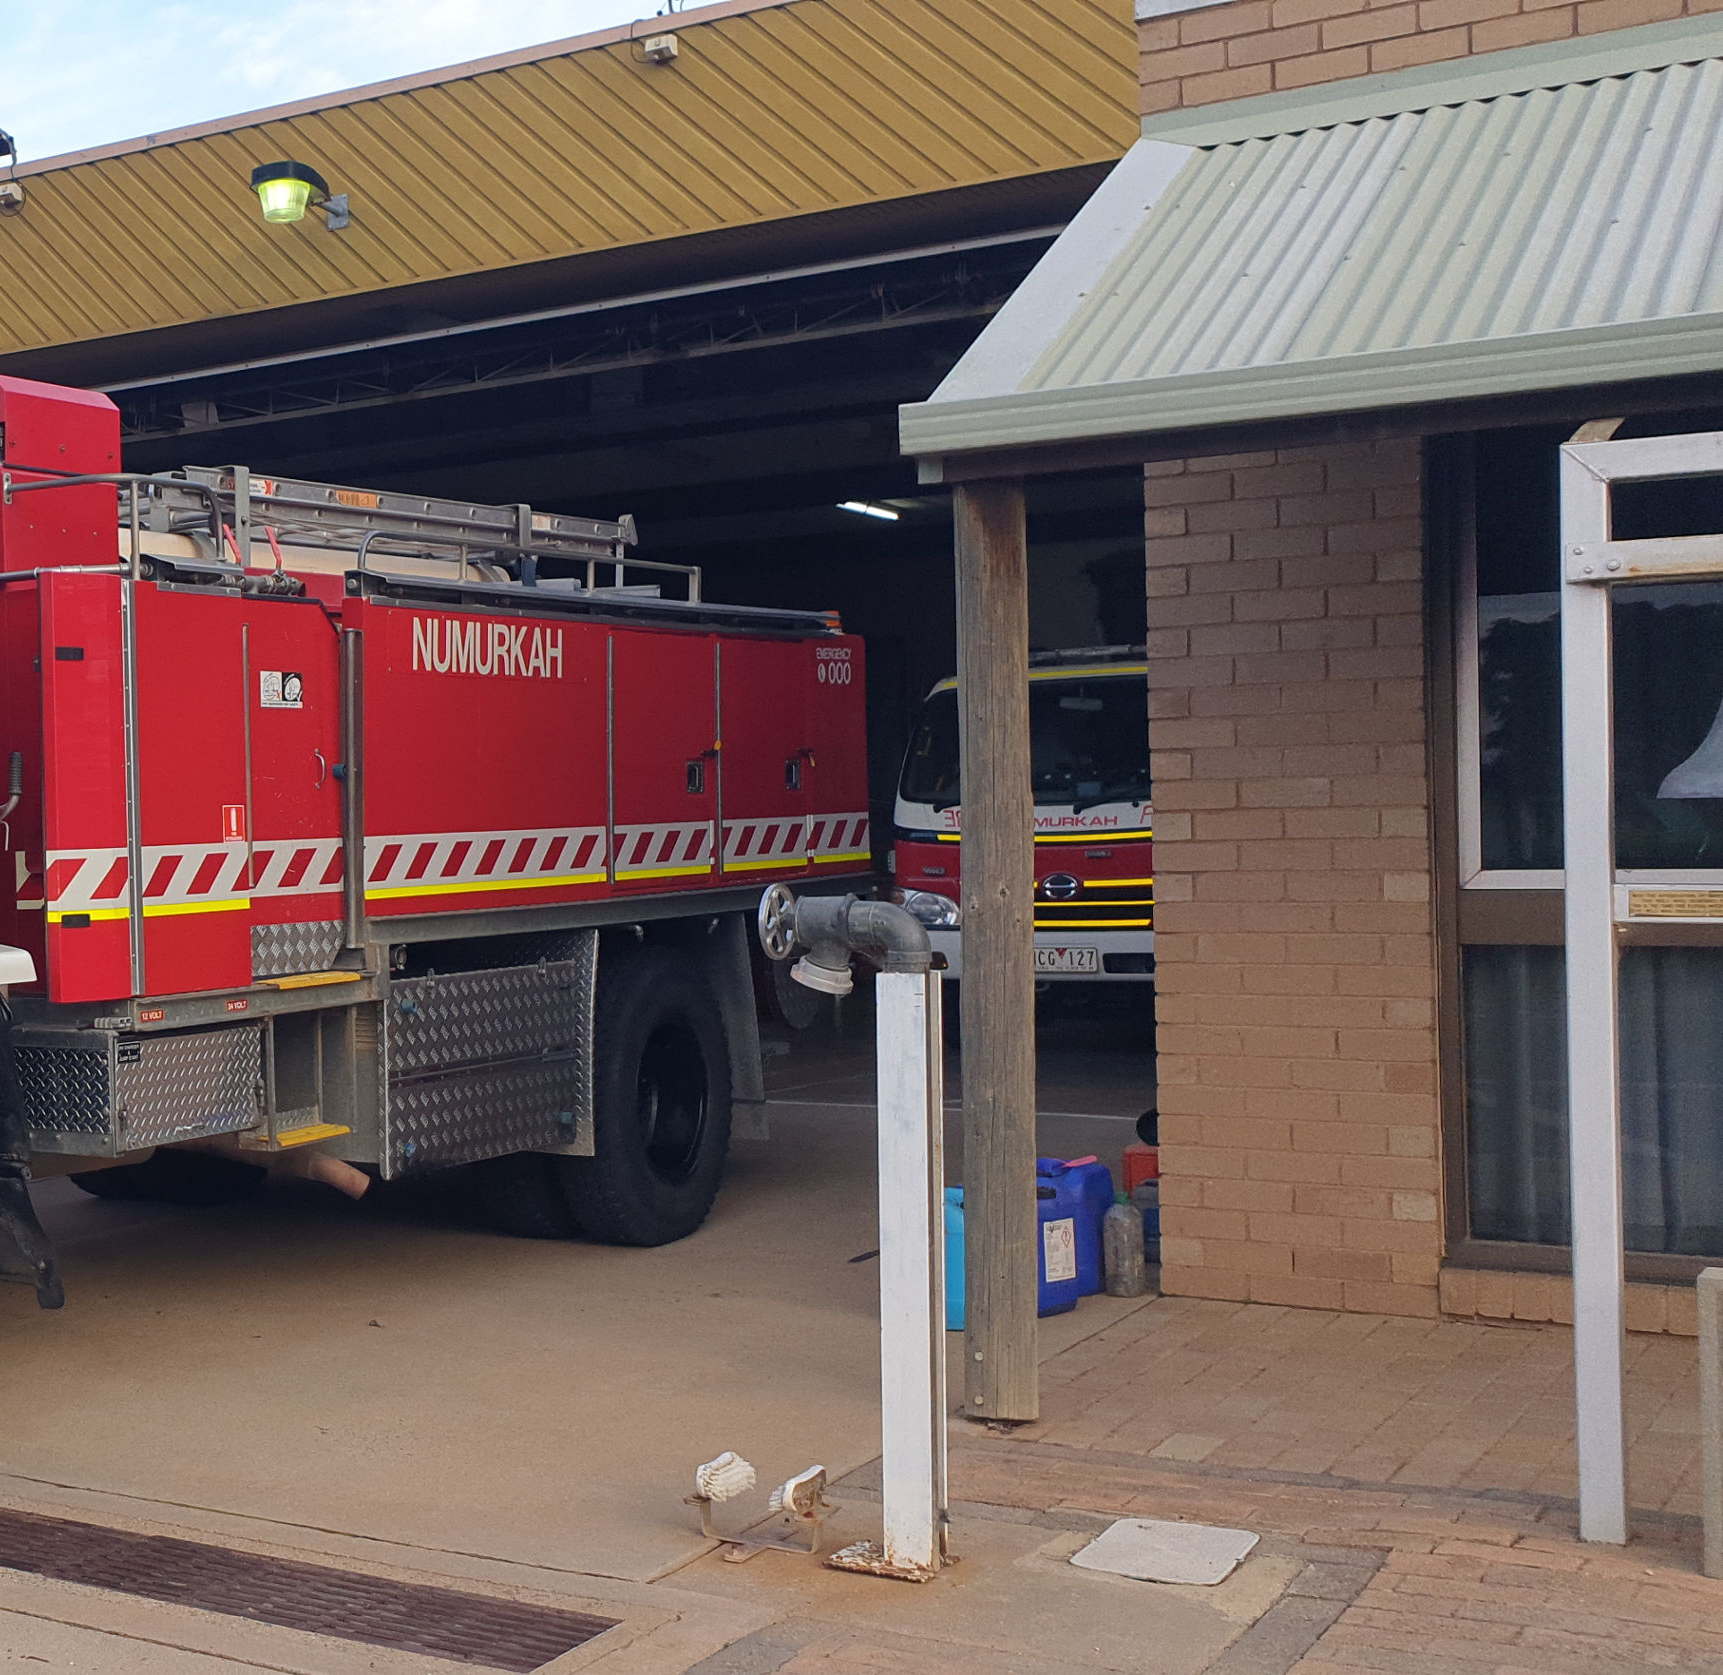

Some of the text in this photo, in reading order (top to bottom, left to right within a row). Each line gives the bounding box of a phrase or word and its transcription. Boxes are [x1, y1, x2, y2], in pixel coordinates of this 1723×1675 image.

[412, 616, 563, 679] NUMURKAH
[828, 661, 852, 685] 000
[1034, 815, 1118, 828] MURKAH
[1069, 950, 1095, 966] 127
[234, 1000, 247, 1010] VOLT
[141, 1010, 162, 1021] 12 VOLT
